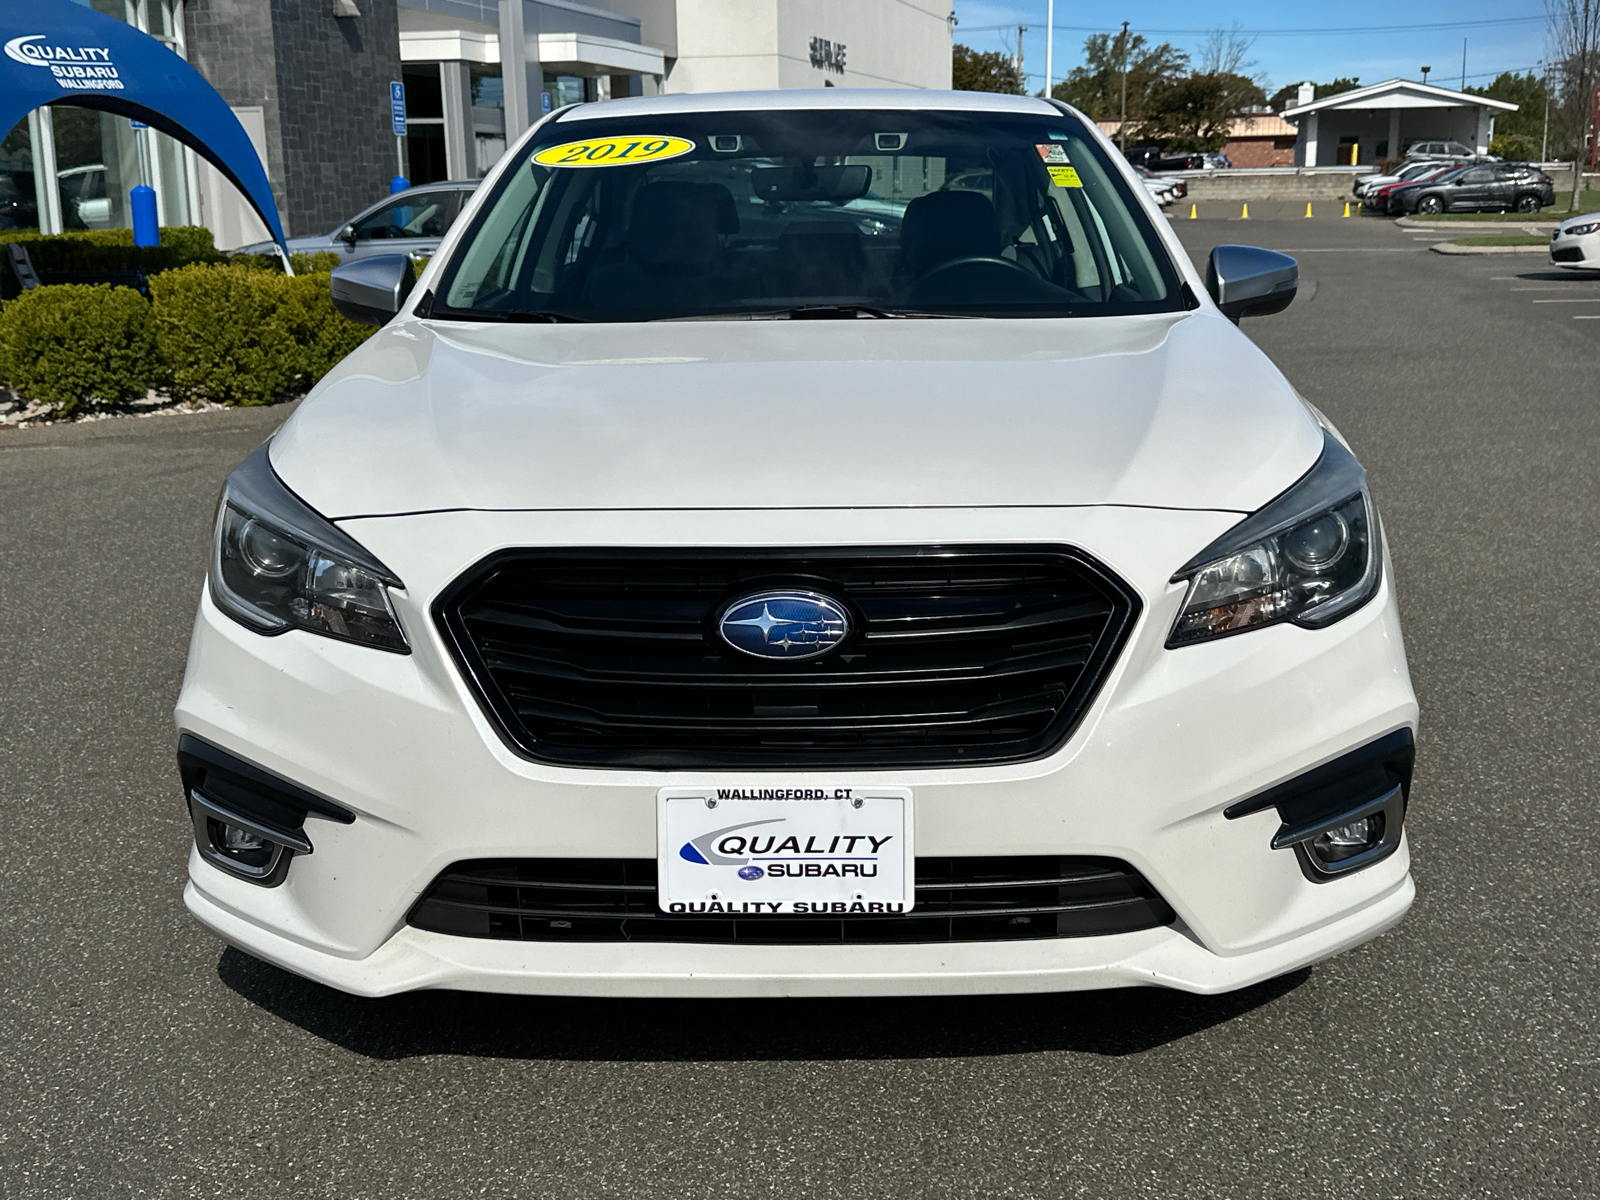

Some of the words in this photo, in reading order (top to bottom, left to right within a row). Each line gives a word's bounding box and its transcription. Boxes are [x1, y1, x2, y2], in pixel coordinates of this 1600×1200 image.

[22, 44, 109, 61] QUALITY
[50, 65, 119, 78] SUBARU
[56, 78, 124, 89] WALLINGFORD
[556, 140, 670, 163] 2019
[717, 789, 829, 801] WALLINGFORD,
[834, 789, 853, 800] CT
[717, 836, 893, 856] QUALITY
[767, 864, 878, 878] SUBARU
[669, 902, 783, 913] QUALITY
[793, 902, 904, 913] SUBARU
